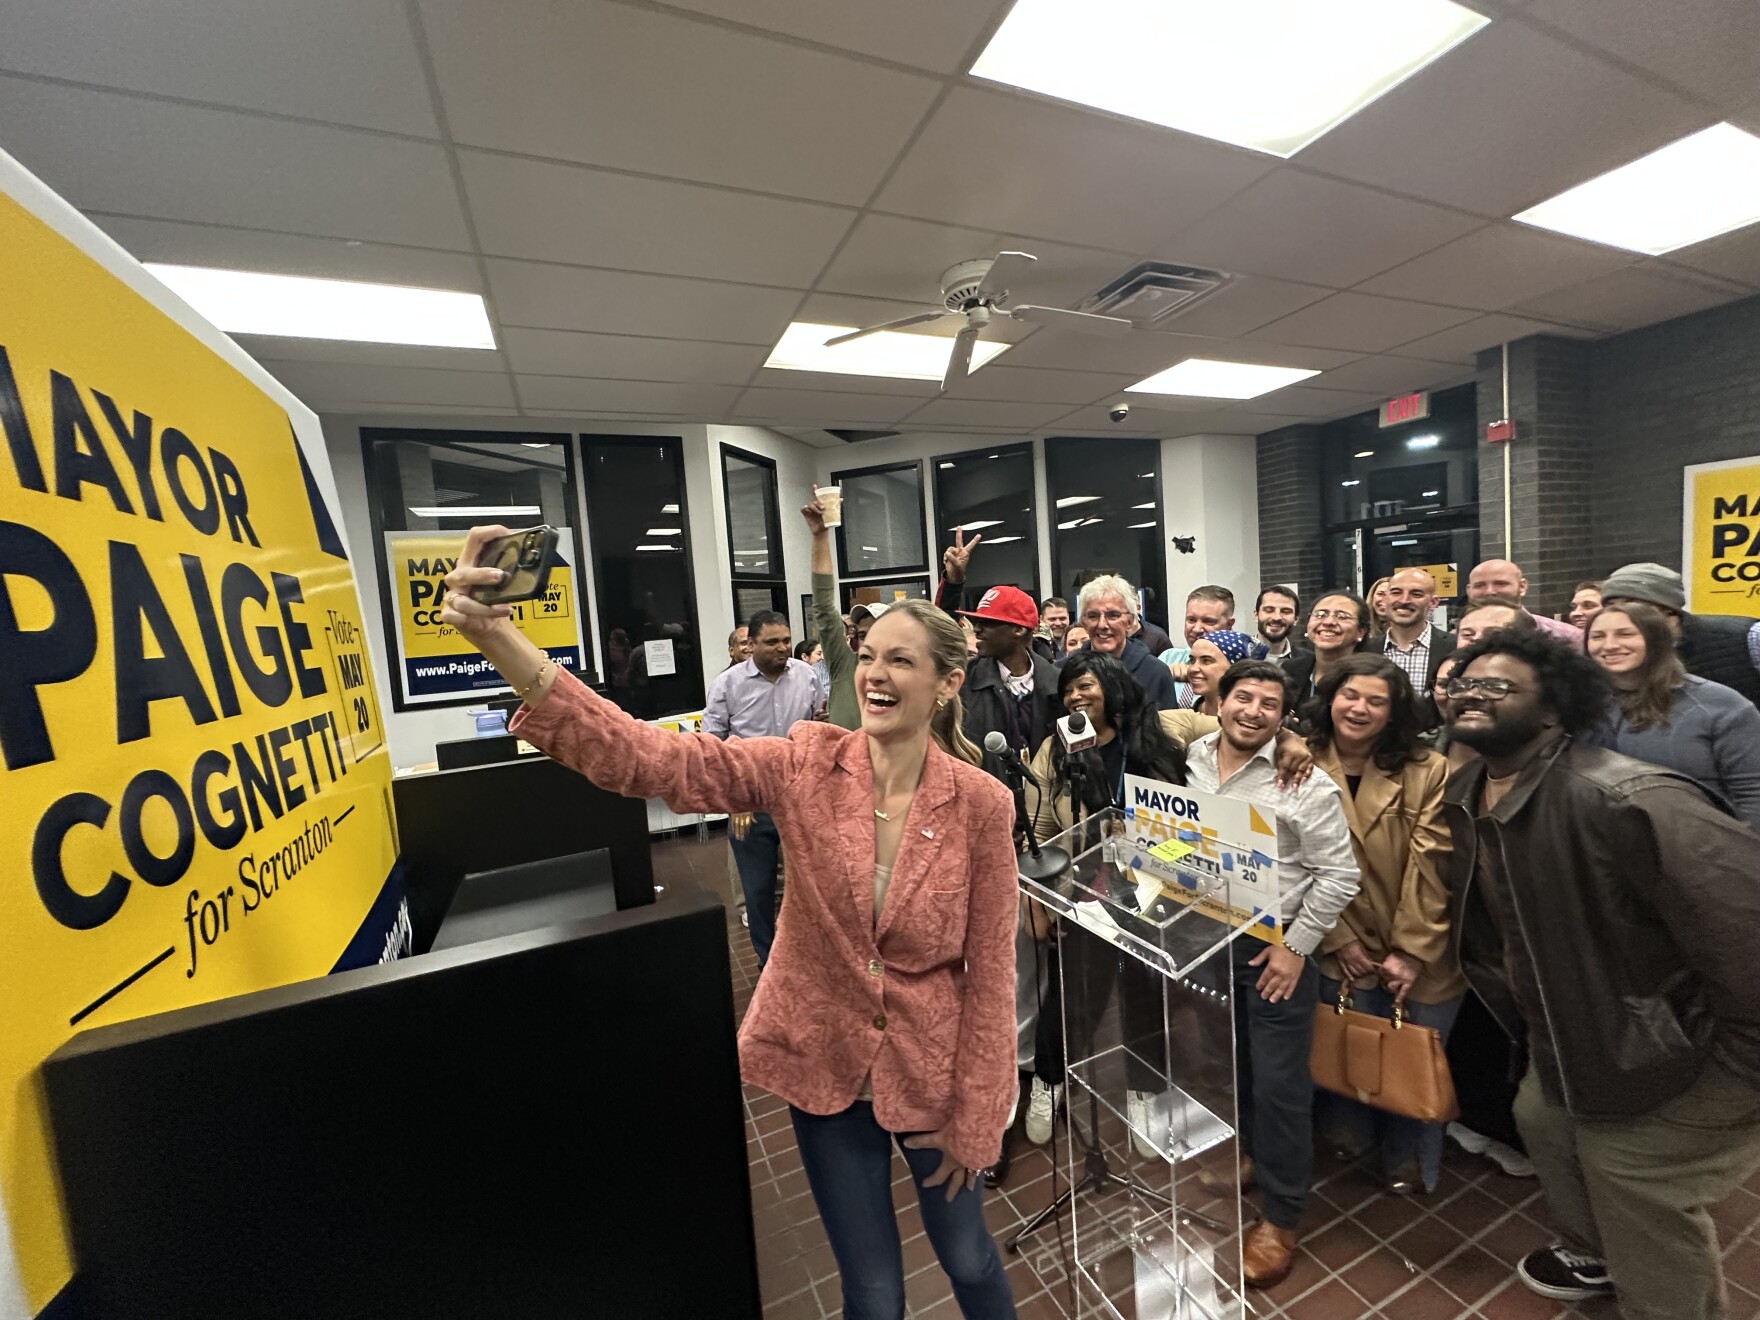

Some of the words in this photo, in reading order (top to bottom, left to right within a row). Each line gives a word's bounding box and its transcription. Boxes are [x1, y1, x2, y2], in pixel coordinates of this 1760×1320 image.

[1387, 393, 1421, 423] EXIT
[408, 557, 460, 577] MAY
[538, 591, 561, 602] MAY
[543, 603, 558, 613] 20
[327, 609, 355, 645] Vote
[438, 626, 454, 638] for
[0, 519, 328, 772] PAIGE
[337, 653, 364, 690] MAY
[353, 696, 370, 733] 20
[1135, 786, 1200, 822] MAYOR
[31, 711, 347, 931] COGNETTI
[1236, 853, 1260, 870] MAY
[1242, 868, 1257, 883] 20
[183, 888, 234, 978] for
[237, 815, 334, 917] Scranton
